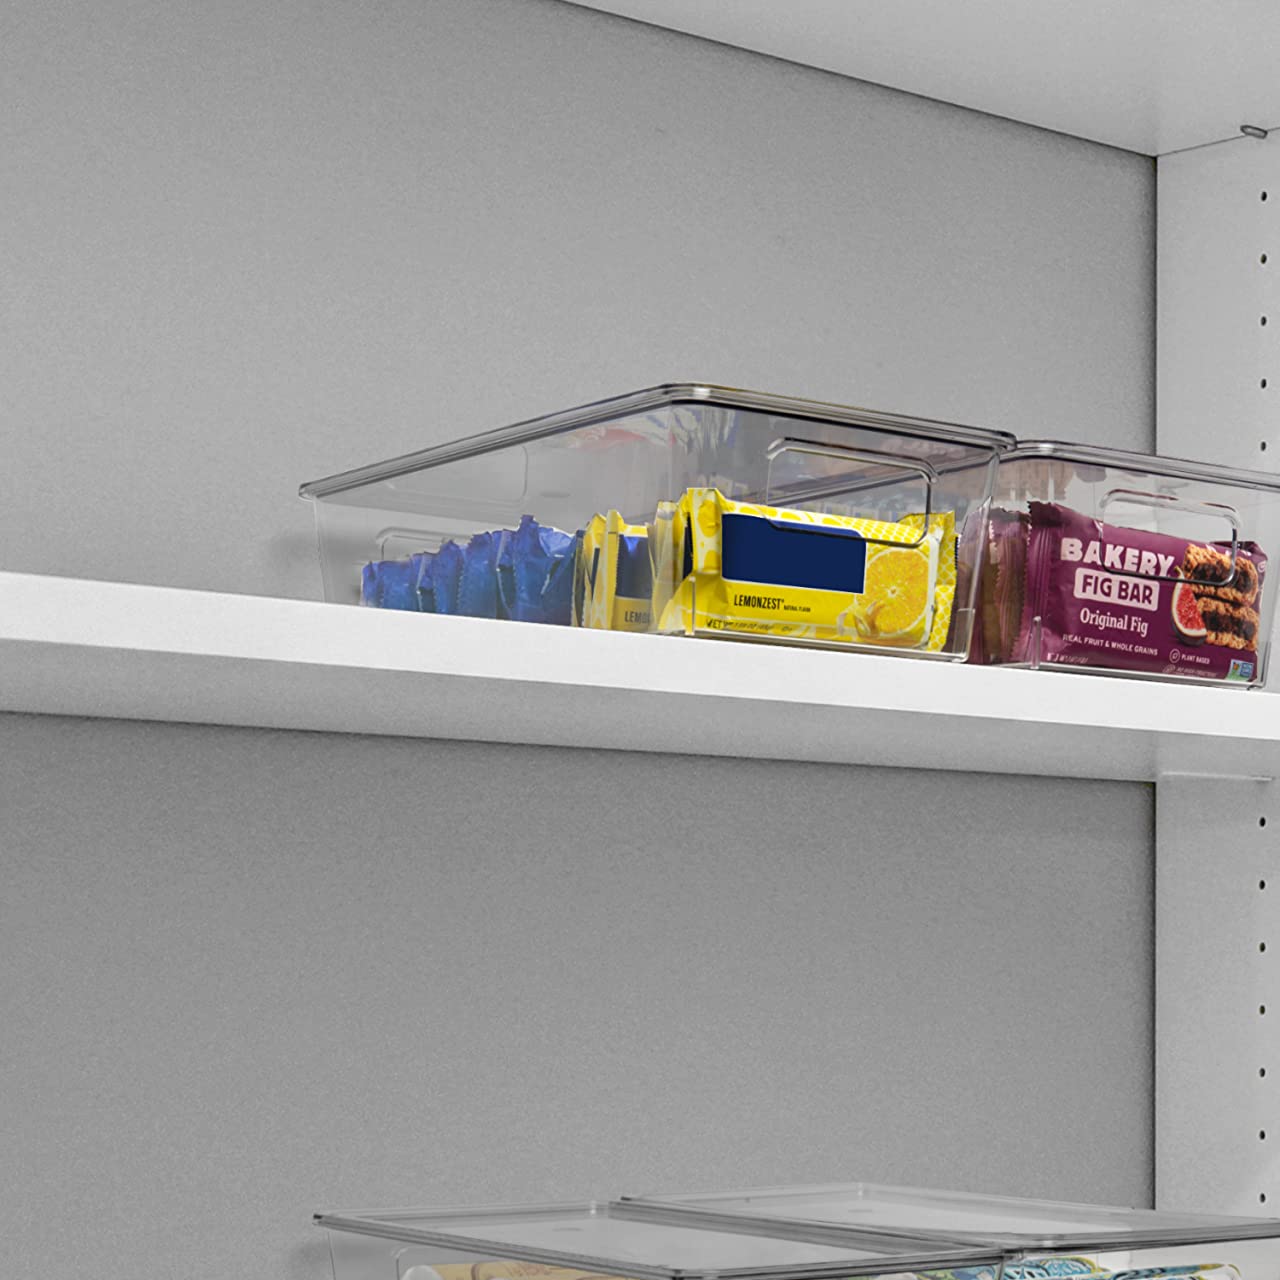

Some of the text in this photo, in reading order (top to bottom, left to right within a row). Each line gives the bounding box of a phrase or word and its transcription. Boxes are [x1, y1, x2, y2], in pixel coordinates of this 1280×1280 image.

[1061, 537, 1175, 577] BAKERY
[1082, 574, 1153, 605] FIG BAR
[1080, 607, 1149, 638] Original Fig
[1063, 634, 1158, 656] REAL FRUIT & WHOLE GRAINS
